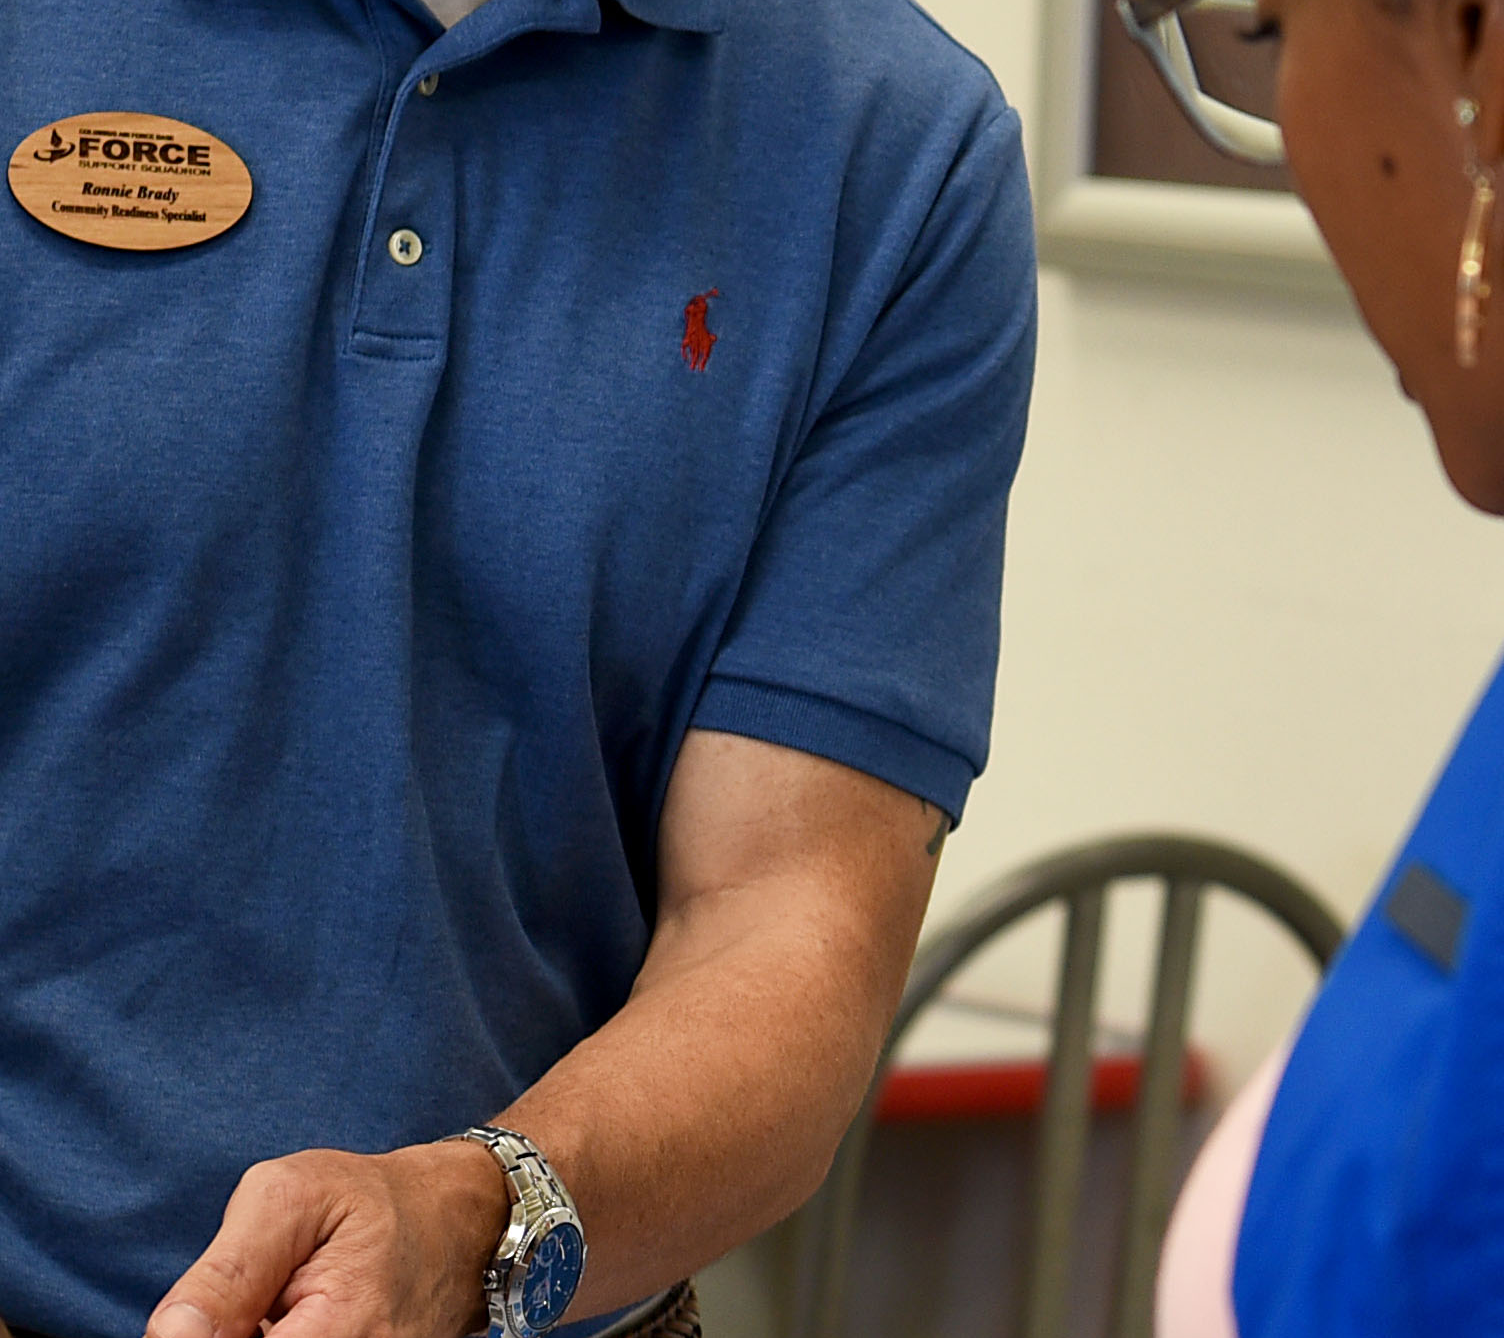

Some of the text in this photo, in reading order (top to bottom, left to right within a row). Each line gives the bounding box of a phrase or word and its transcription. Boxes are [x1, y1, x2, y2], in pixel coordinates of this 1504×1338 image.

[78, 137, 210, 167] FORCE
[79, 160, 211, 177] SUPPORT SQUADRON
[81, 182, 180, 205] Ronnie Brady
[51, 200, 207, 224] Community Readiness Specialist
